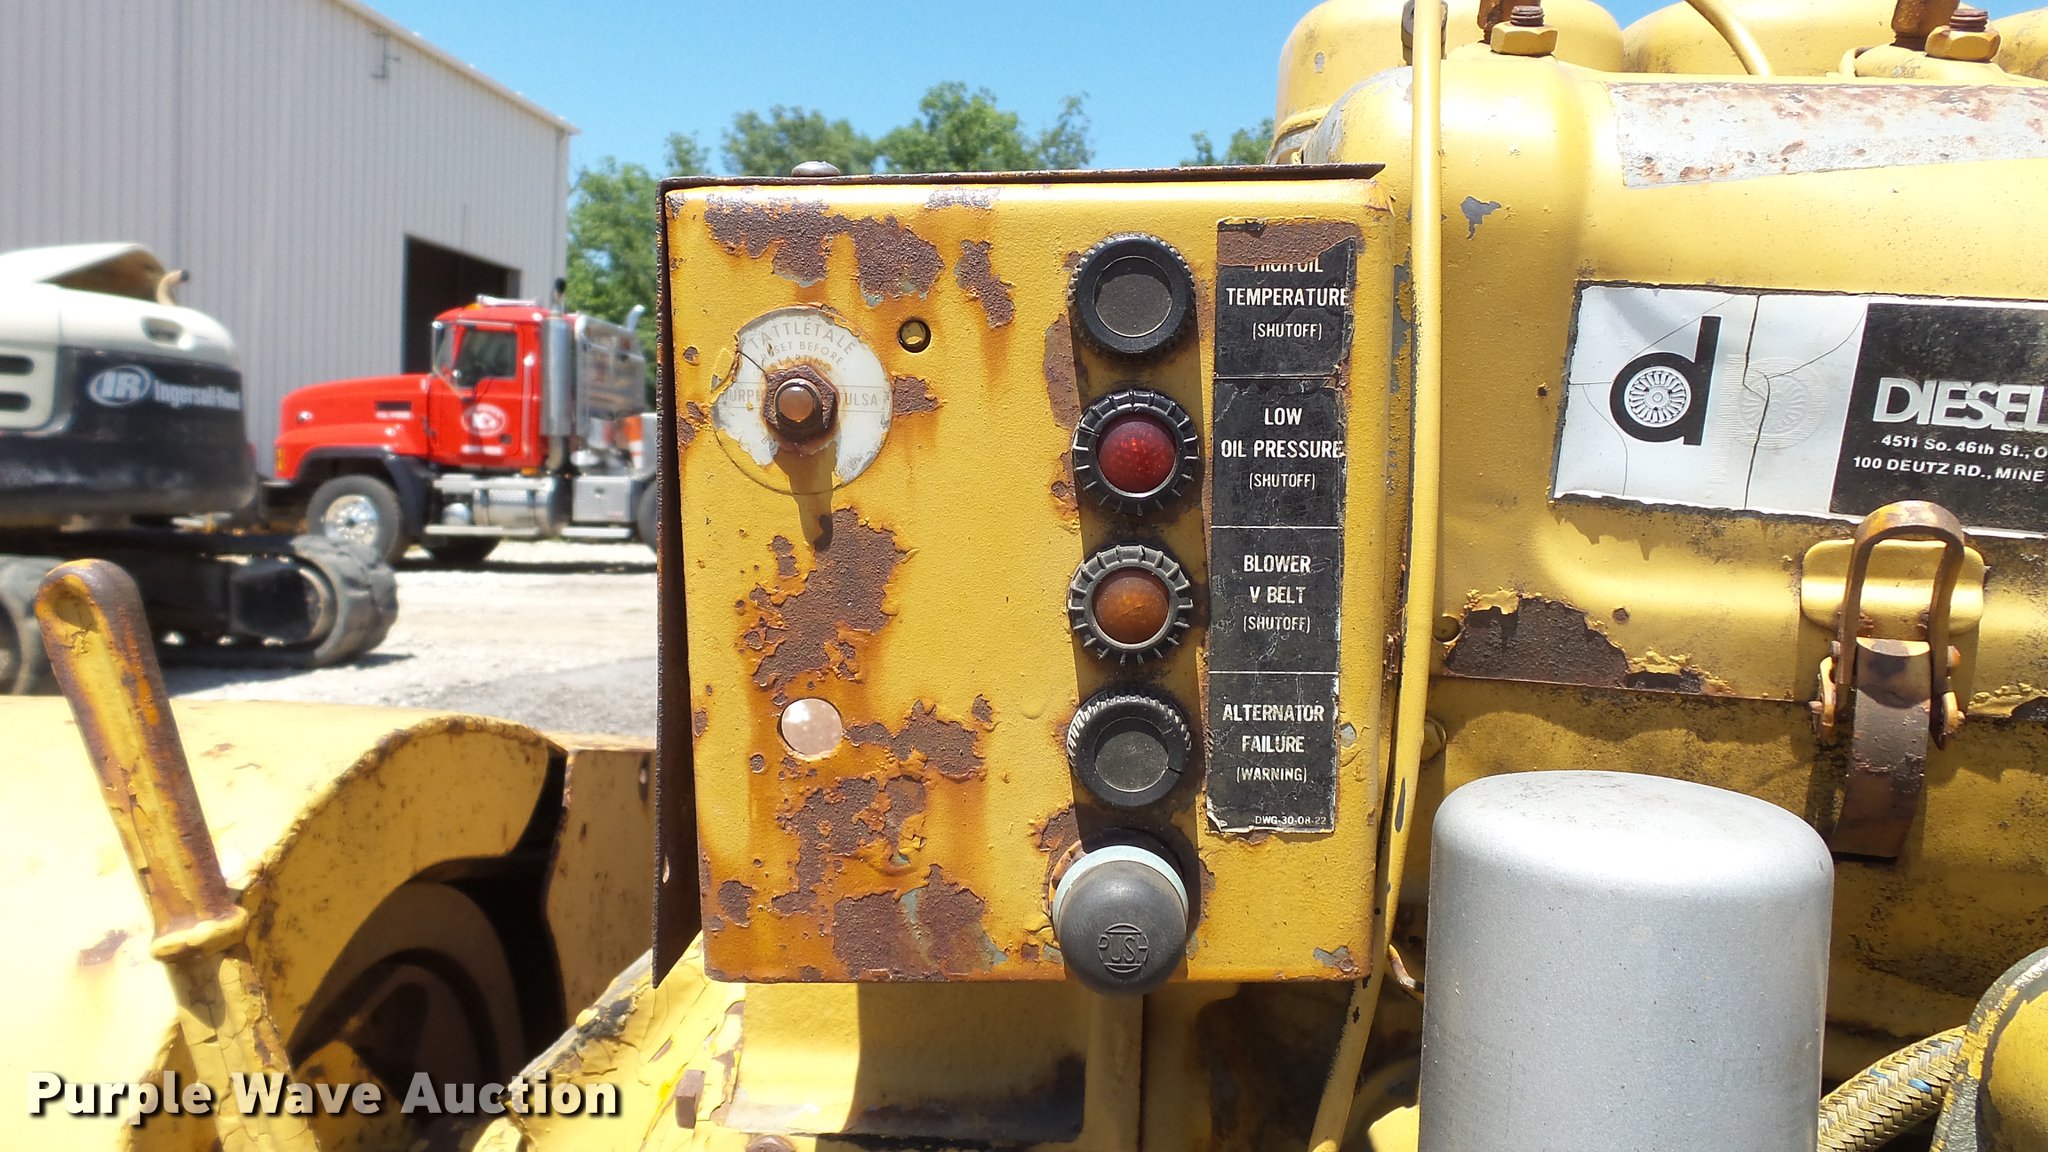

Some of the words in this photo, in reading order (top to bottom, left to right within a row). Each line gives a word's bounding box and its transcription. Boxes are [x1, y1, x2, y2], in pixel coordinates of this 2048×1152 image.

[1226, 287, 1349, 306] TEMPERATURE
[748, 322, 857, 355] TATTLETALE
[1252, 322, 1322, 340] (SHUTOFF)
[799, 341, 844, 366] BEFORE
[99, 371, 143, 399] IR
[1872, 376, 2048, 434] DIESEL
[1263, 407, 1303, 426] LOW
[1220, 439, 1247, 458] OIL
[1253, 439, 1346, 459] PRESSURE
[1881, 434, 1918, 448] 4511
[1924, 438, 1952, 452] So.
[1955, 440, 1995, 455] 46th
[1999, 443, 2030, 460] St.,
[1853, 456, 1882, 470] 100
[1886, 459, 1950, 475] DEUTZ
[1953, 464, 1992, 480] RD.,
[1995, 467, 2046, 483] MINE
[1249, 472, 1316, 490] (SHUTOFF)
[1243, 554, 1312, 573] BLOWER
[1249, 586, 1261, 604] V
[1266, 586, 1306, 604] BELT
[1243, 615, 1311, 634] (SHUTOFF)
[1222, 703, 1325, 722] ALTERNATOR
[1241, 735, 1305, 753] FAILURE
[1236, 766, 1307, 783] (WARNING)
[1098, 934, 1149, 963] PUSH
